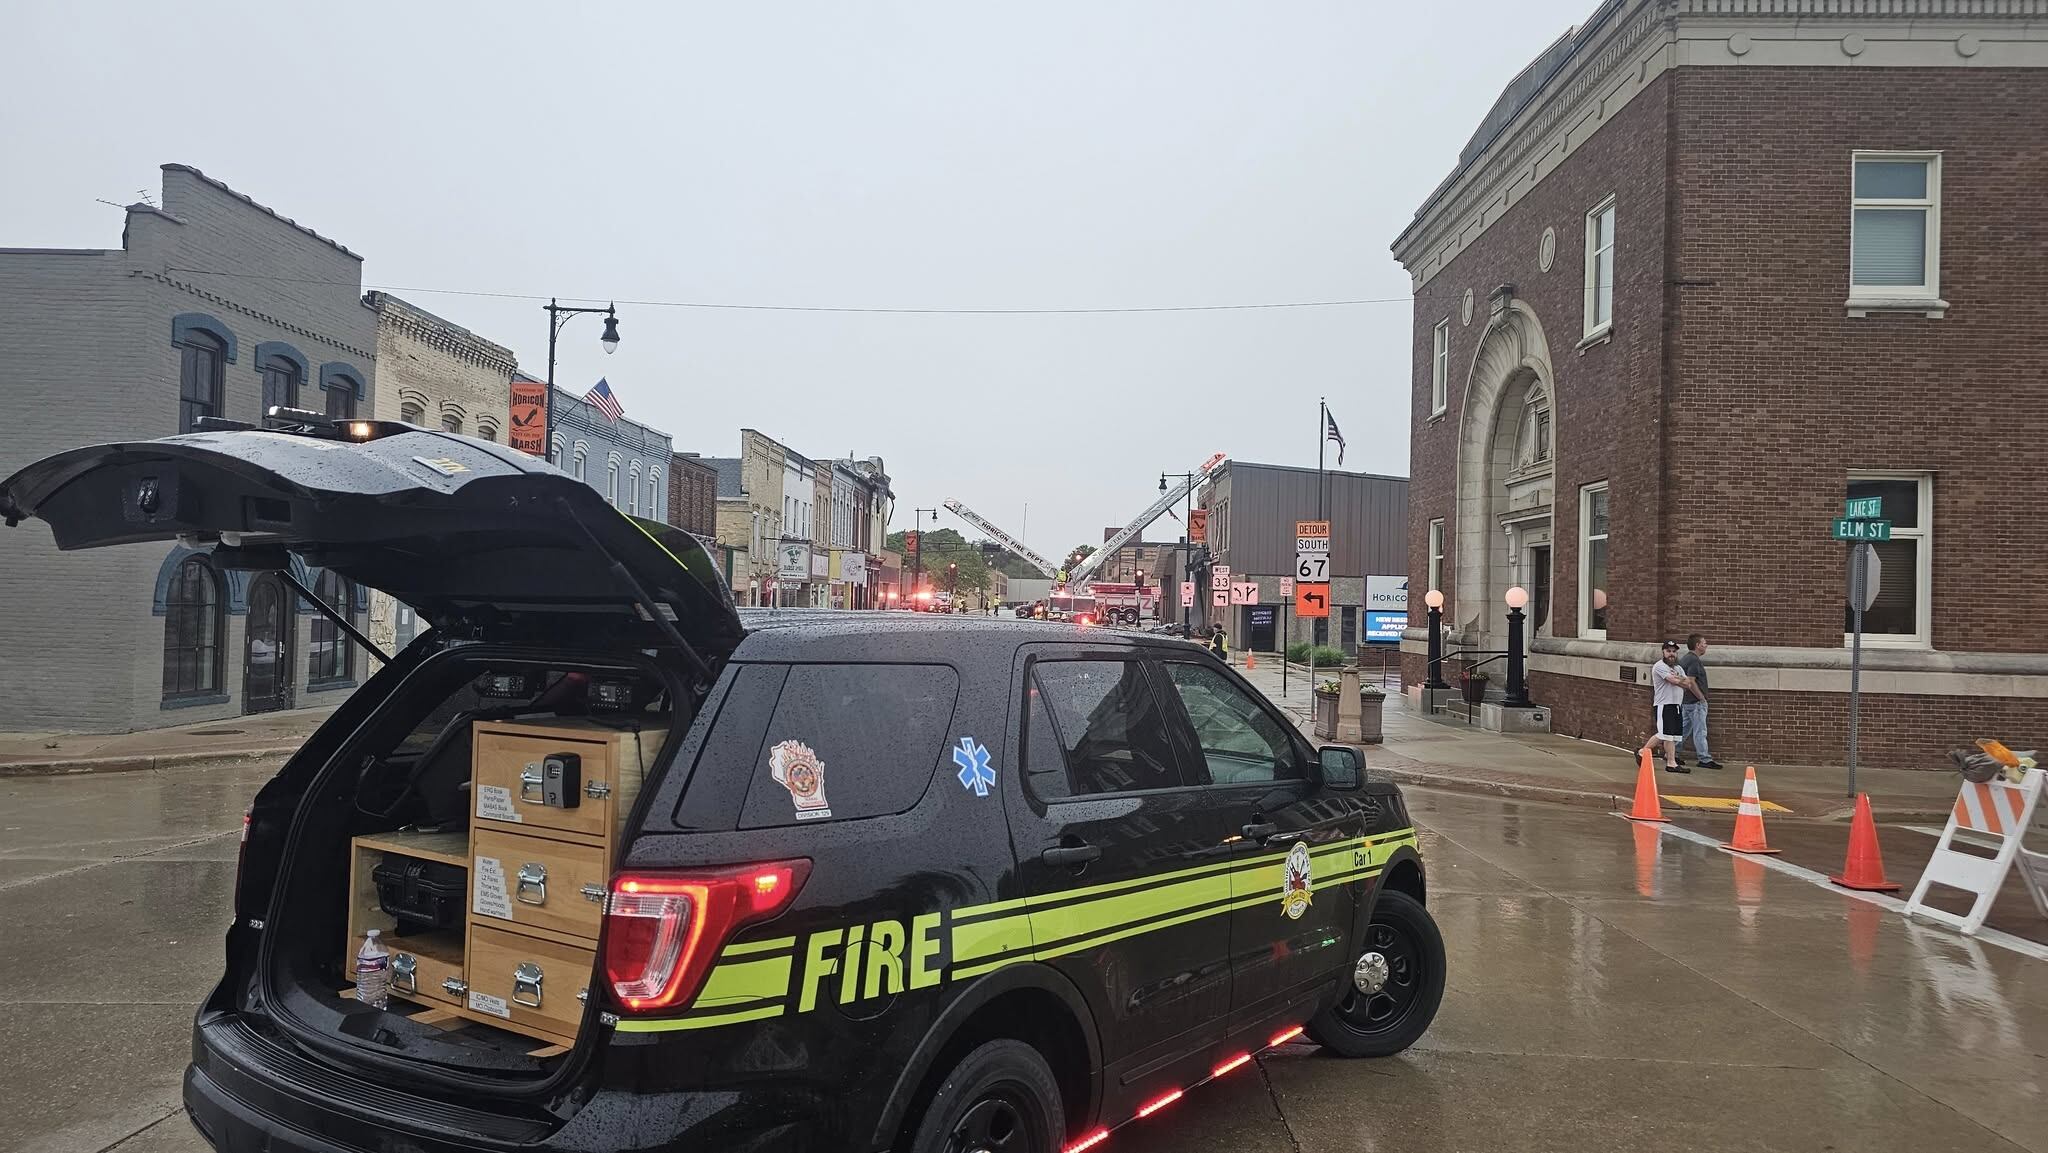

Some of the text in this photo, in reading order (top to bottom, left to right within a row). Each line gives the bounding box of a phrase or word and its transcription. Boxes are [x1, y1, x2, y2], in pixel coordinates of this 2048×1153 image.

[512, 392, 544, 408] HORICON
[512, 437, 542, 452] MARSH
[1850, 500, 1877, 516] LAKE ST
[982, 522, 1008, 541] HORICON
[1011, 541, 1023, 552] FIRE
[1300, 525, 1326, 534] DETOUR
[1840, 522, 1884, 537] ELM ST
[1299, 539, 1328, 549] SOUTH
[1300, 560, 1326, 577] 67
[1215, 578, 1228, 587] 33
[1354, 850, 1372, 867] Car 1
[799, 912, 941, 1013] FIRE
